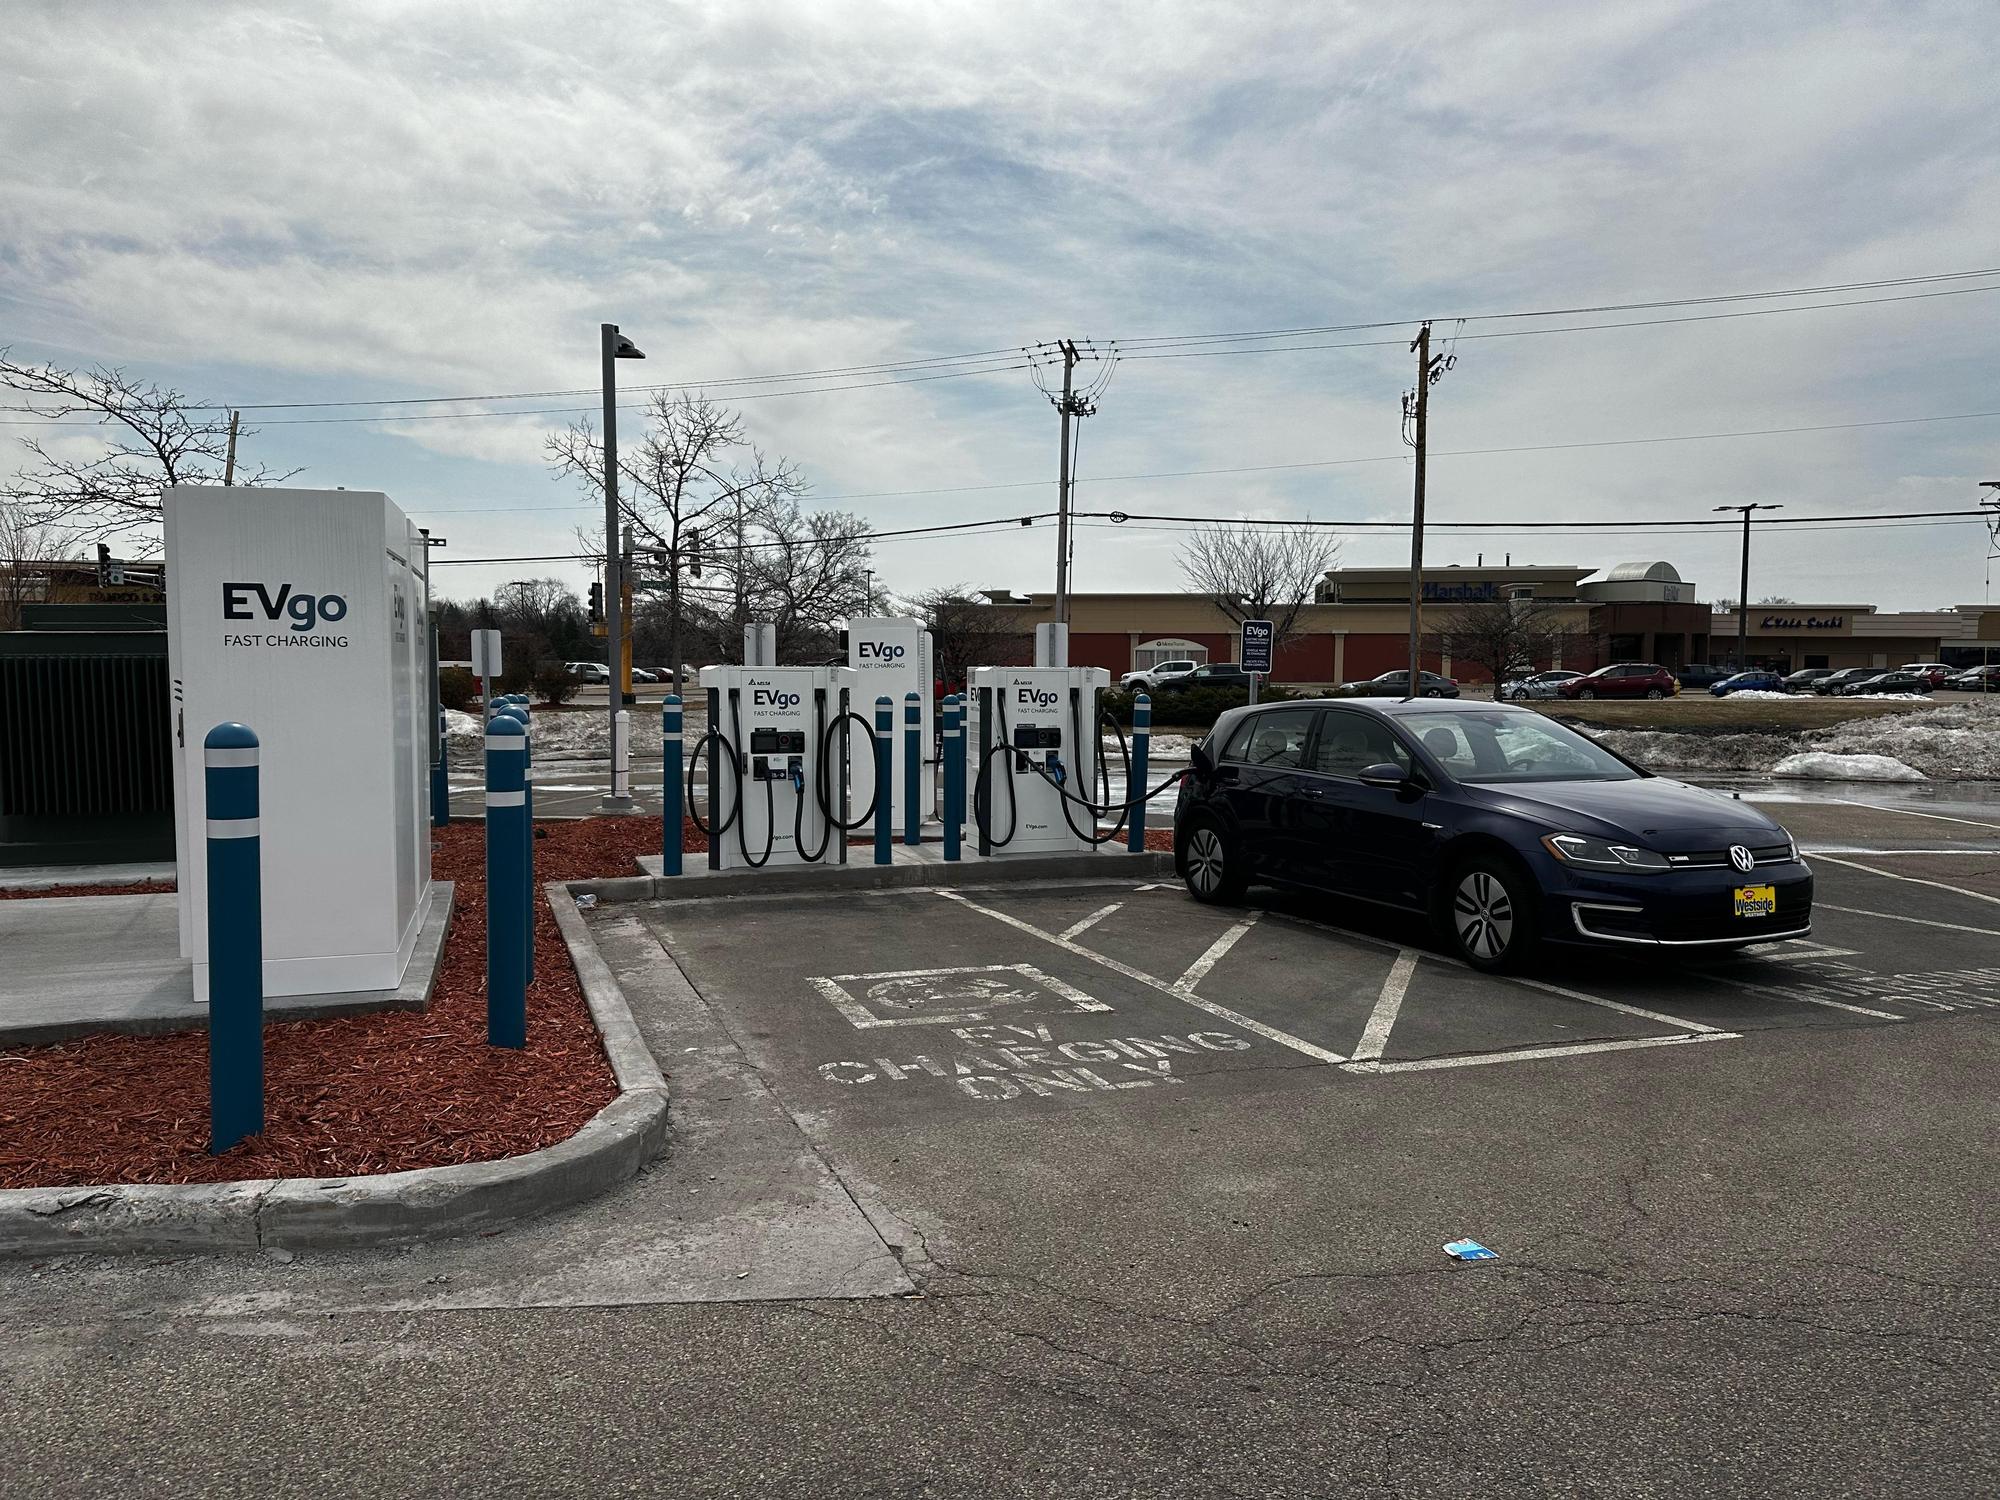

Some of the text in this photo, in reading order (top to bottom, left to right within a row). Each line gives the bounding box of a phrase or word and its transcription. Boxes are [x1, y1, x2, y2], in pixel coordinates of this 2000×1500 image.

[222, 582, 348, 632] EVgo
[224, 634, 349, 648] FAST CHARGING
[1246, 626, 1269, 638] EVgo
[858, 641, 905, 662] EVgo
[754, 689, 801, 710] EVgo
[1018, 688, 1059, 708] EVgo
[1735, 897, 1774, 913] Westside
[950, 1022, 1054, 1047] EV
[817, 1031, 1252, 1085] CHARGING
[955, 1059, 1185, 1101] ONLY
